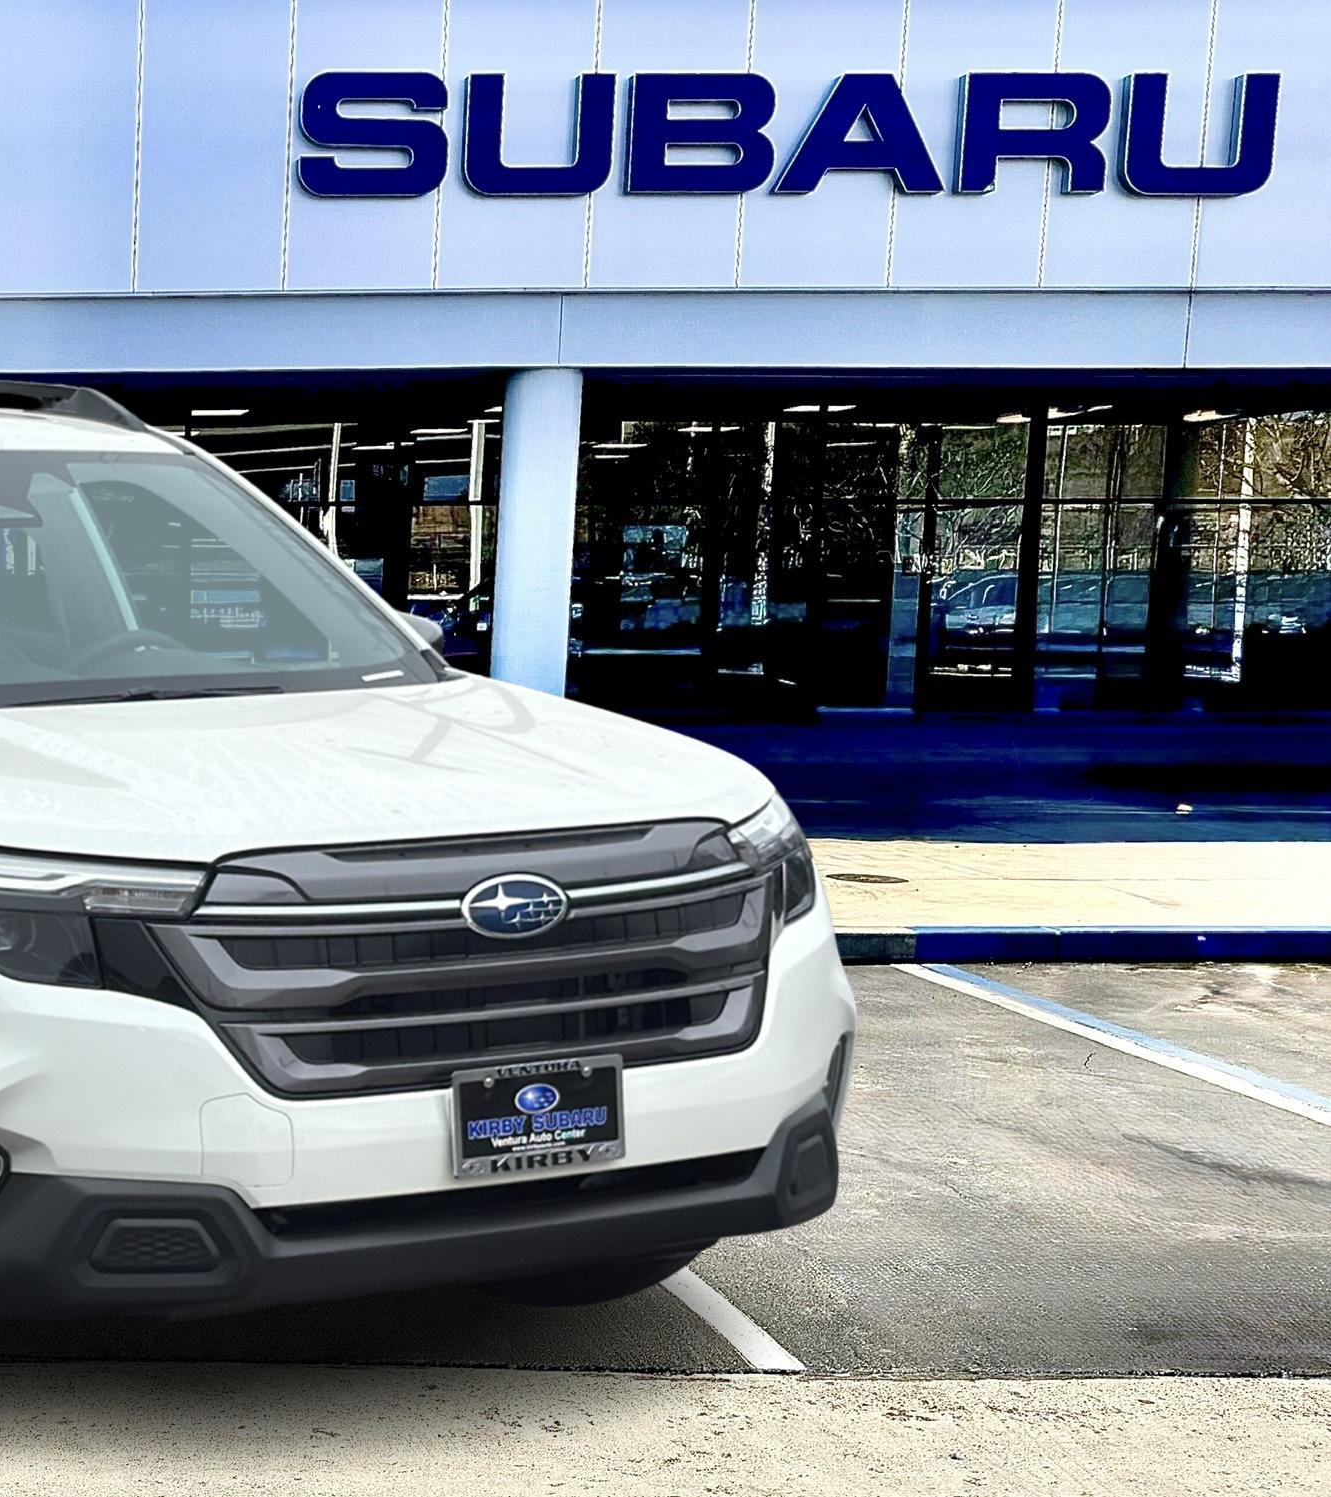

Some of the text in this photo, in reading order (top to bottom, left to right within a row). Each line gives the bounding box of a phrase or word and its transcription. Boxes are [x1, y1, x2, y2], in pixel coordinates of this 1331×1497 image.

[296, 70, 1283, 198] SUBARU
[496, 1058, 582, 1078] VENTURA
[468, 1106, 607, 1139] KIRBY SUBARU
[491, 1133, 527, 1148] Ventura
[529, 1130, 552, 1144] Auto
[554, 1127, 586, 1140] Center
[491, 1146, 593, 1173] KIRBY
